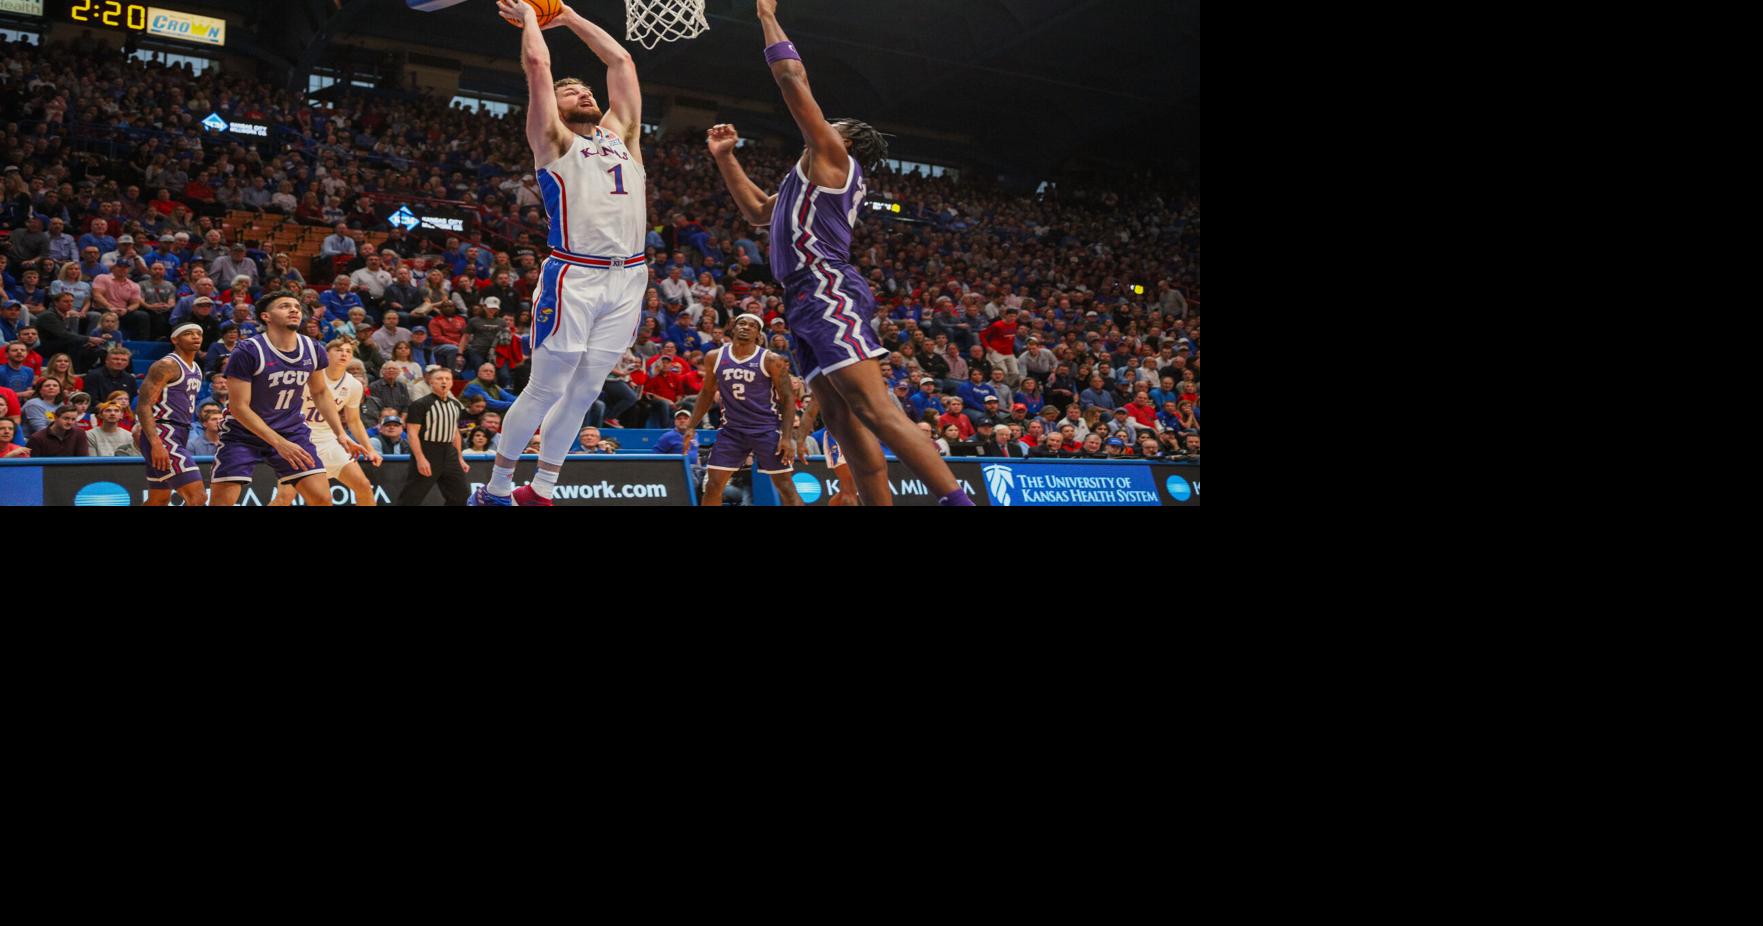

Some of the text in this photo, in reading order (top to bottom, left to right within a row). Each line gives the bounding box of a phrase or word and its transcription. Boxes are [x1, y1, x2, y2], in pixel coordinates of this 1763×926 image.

[72, 0, 145, 30] 2:20
[607, 163, 628, 195] 1
[268, 370, 309, 388] TCU
[723, 368, 755, 382] TCU
[186, 378, 201, 392] TCU
[732, 383, 745, 400] 2
[189, 394, 195, 413] 3
[274, 389, 295, 410] 11
[1016, 475, 1131, 488] THE UNIVERSITY OF
[1022, 489, 1159, 502] KANSAS HEALTH SYSTEM
